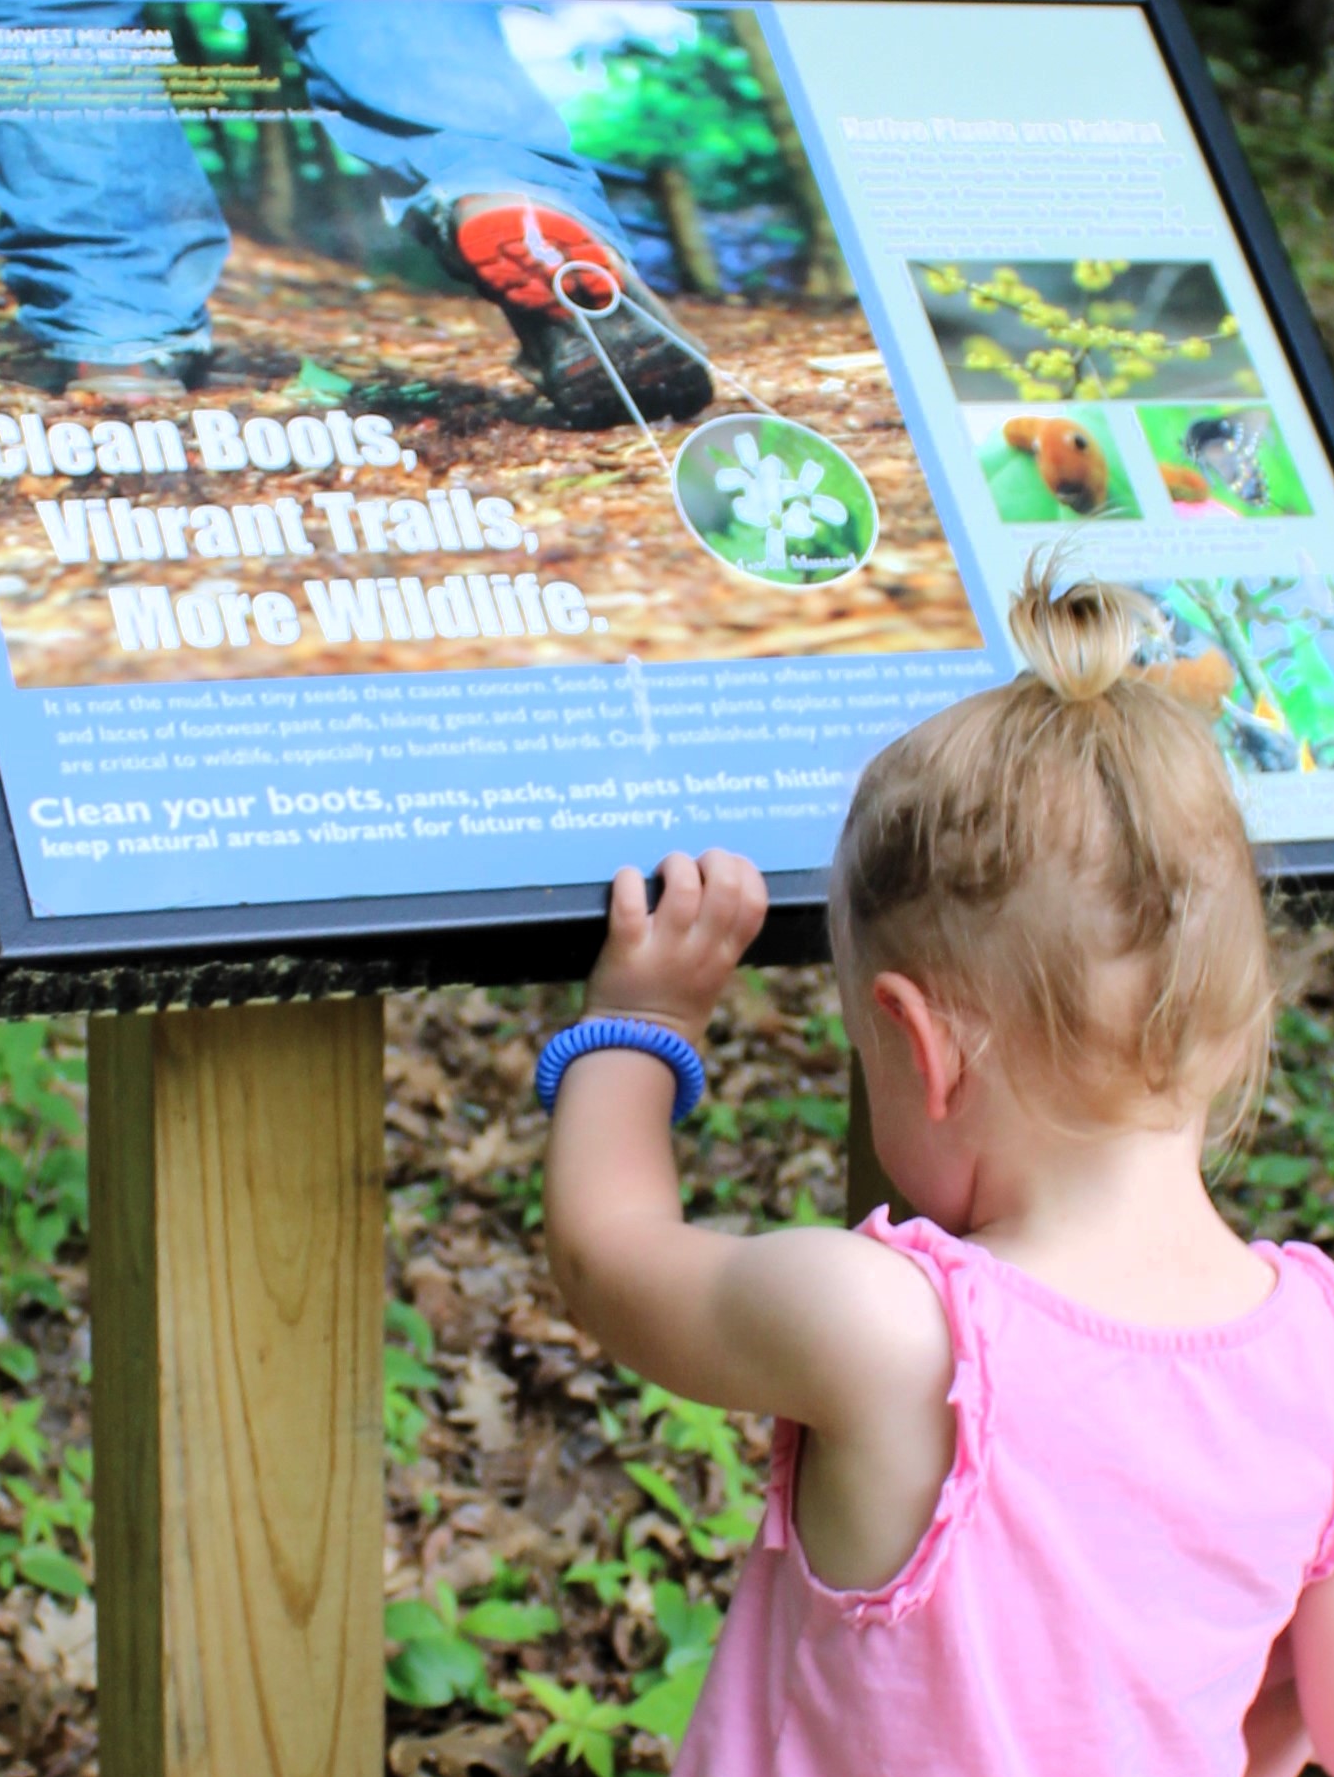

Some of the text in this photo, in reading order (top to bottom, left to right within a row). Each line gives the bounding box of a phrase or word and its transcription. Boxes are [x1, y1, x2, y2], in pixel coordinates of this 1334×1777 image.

[32, 48, 94, 64] SPECIES
[97, 49, 177, 64] NETWORK
[76, 28, 173, 47] MICHIGAN
[192, 408, 417, 472] Boots,
[35, 488, 540, 564] Vibrant Trails,
[107, 572, 609, 651] More Wildlife.
[43, 697, 60, 717] It
[64, 698, 82, 716] is
[87, 698, 124, 715] not
[127, 695, 163, 714] the
[220, 689, 255, 709] but
[259, 688, 297, 711] tiny
[303, 686, 358, 705] seeds
[362, 683, 403, 702] that
[407, 684, 462, 701] cause
[466, 680, 551, 699] concern.
[552, 674, 608, 693] Seeds
[713, 669, 769, 691] plants
[772, 666, 823, 685] often
[826, 663, 878, 683] travel
[882, 665, 899, 681] in
[902, 661, 935, 680] the
[938, 658, 994, 678] treads
[56, 725, 93, 746] and
[97, 721, 149, 743] laces
[153, 721, 176, 740] of
[178, 719, 278, 740] footwear,
[279, 718, 323, 740] pant
[379, 708, 441, 733] hiking
[490, 706, 527, 724] and
[531, 707, 558, 725] on
[562, 705, 595, 726] pet
[710, 697, 766, 719] plants
[769, 693, 843, 715] displace
[847, 691, 900, 709] native
[59, 758, 95, 776] are
[98, 750, 168, 775] critical
[173, 751, 197, 769] to
[201, 746, 282, 768] wildlife,
[282, 740, 374, 768] especially
[378, 742, 404, 760] to
[406, 737, 508, 760] butterflies
[512, 733, 549, 752] and
[551, 730, 601, 750] birds.
[777, 721, 816, 745] they
[822, 721, 853, 741] are
[28, 765, 845, 832] Clean your boots, pants, packs, and pets before hittin
[39, 834, 111, 863] keep
[116, 825, 220, 855] natural
[225, 827, 302, 849] areas
[306, 818, 407, 844] vibrant
[410, 813, 452, 838] for
[457, 811, 545, 836] future
[549, 805, 681, 833] discovery.
[684, 803, 712, 822] To
[713, 803, 764, 821] learn
